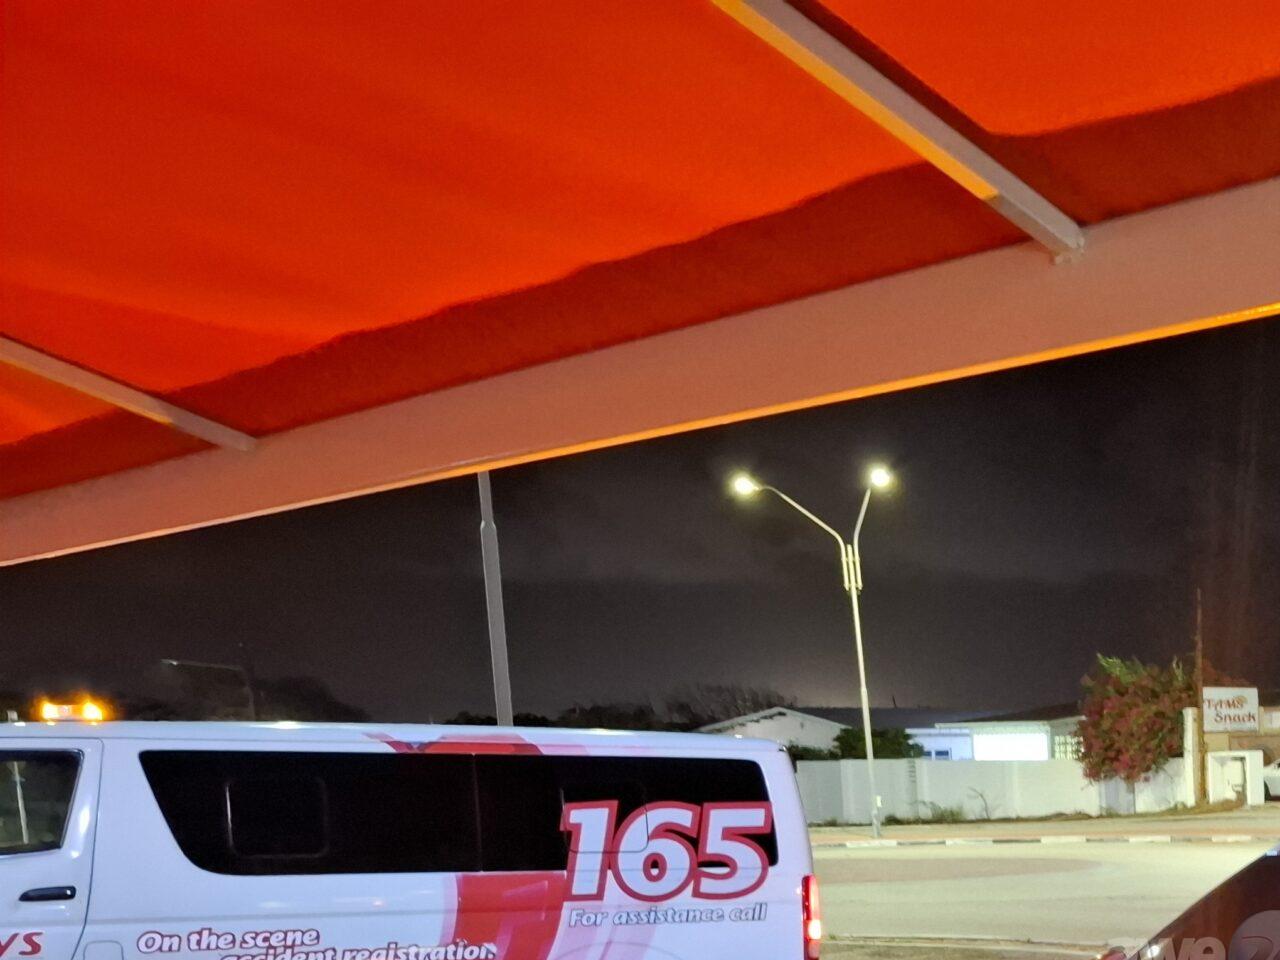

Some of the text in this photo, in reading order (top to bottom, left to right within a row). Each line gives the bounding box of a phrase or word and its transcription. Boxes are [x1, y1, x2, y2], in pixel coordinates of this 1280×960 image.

[560, 799, 774, 902] 165
[569, 902, 768, 927] For assistance call
[137, 927, 320, 953] On the scene
